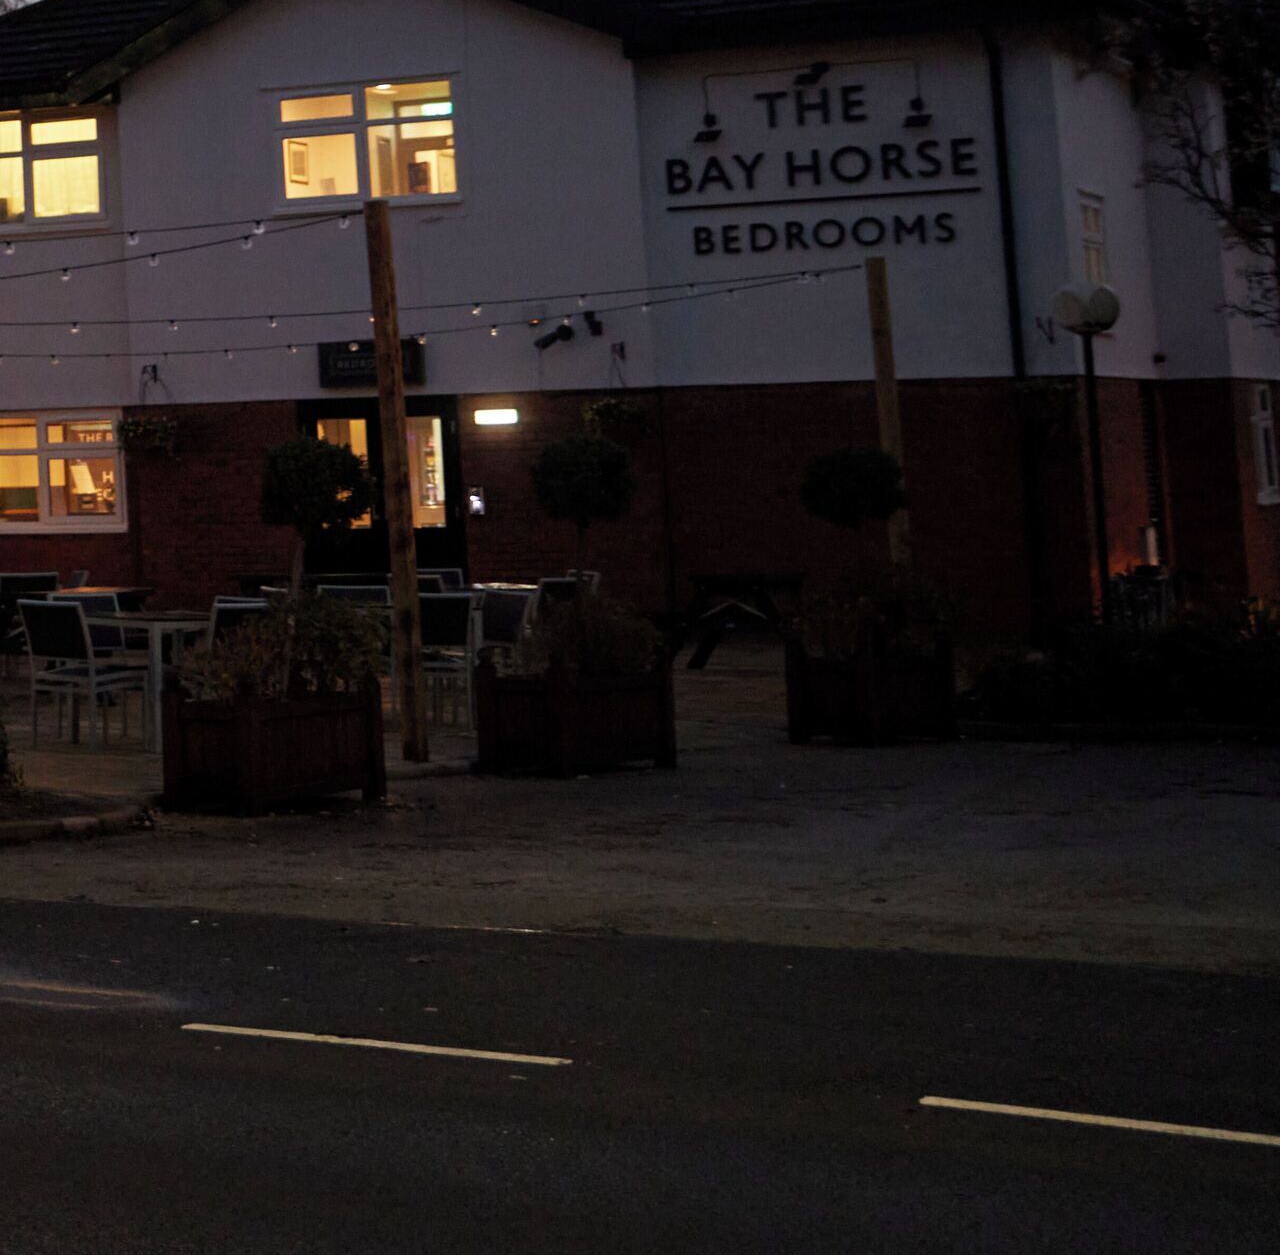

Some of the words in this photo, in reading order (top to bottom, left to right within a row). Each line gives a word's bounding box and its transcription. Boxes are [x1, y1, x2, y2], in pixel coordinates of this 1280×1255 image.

[755, 85, 867, 128] THE
[666, 153, 764, 194] BAY
[786, 138, 978, 187] HORSE
[693, 213, 956, 255] BEDROOMS
